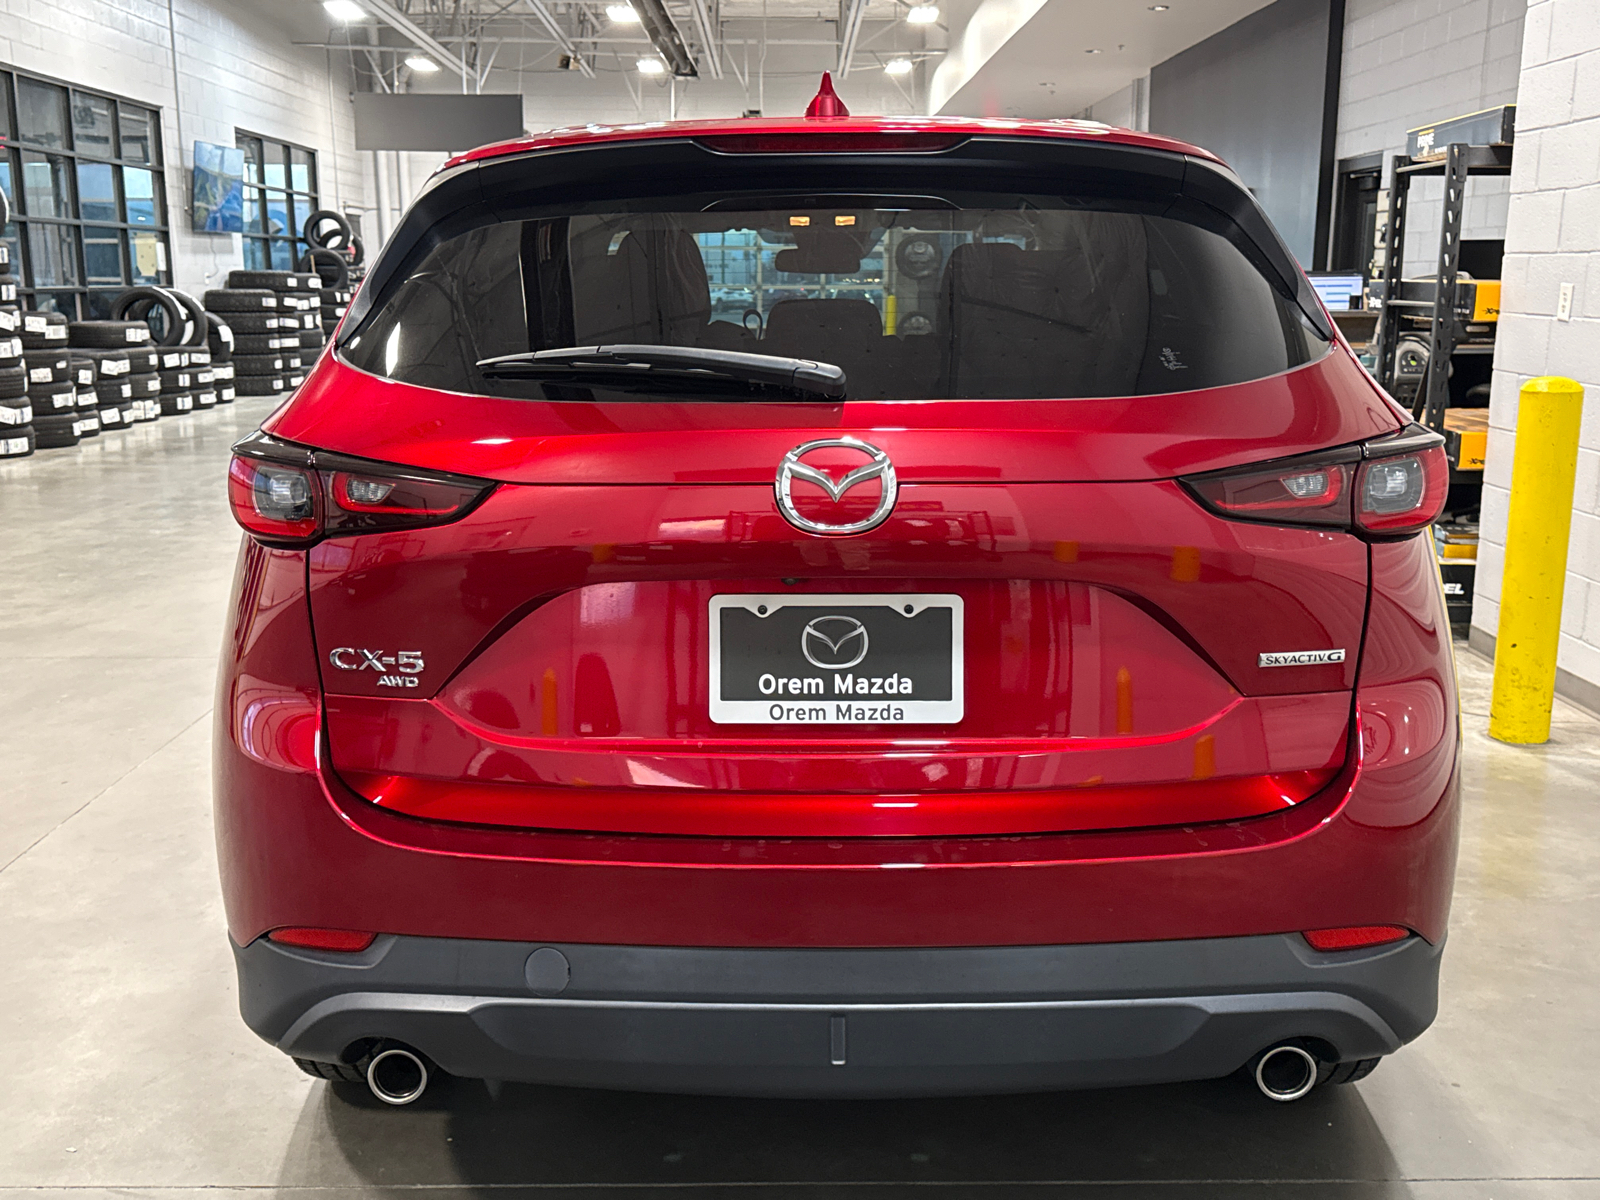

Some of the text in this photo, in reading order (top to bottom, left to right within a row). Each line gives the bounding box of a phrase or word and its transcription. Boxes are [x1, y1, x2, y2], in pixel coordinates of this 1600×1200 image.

[329, 647, 425, 674] CX-5
[376, 675, 419, 688] AWD
[758, 672, 913, 695] Orem Mazda
[769, 703, 904, 721] Orem Mazda
